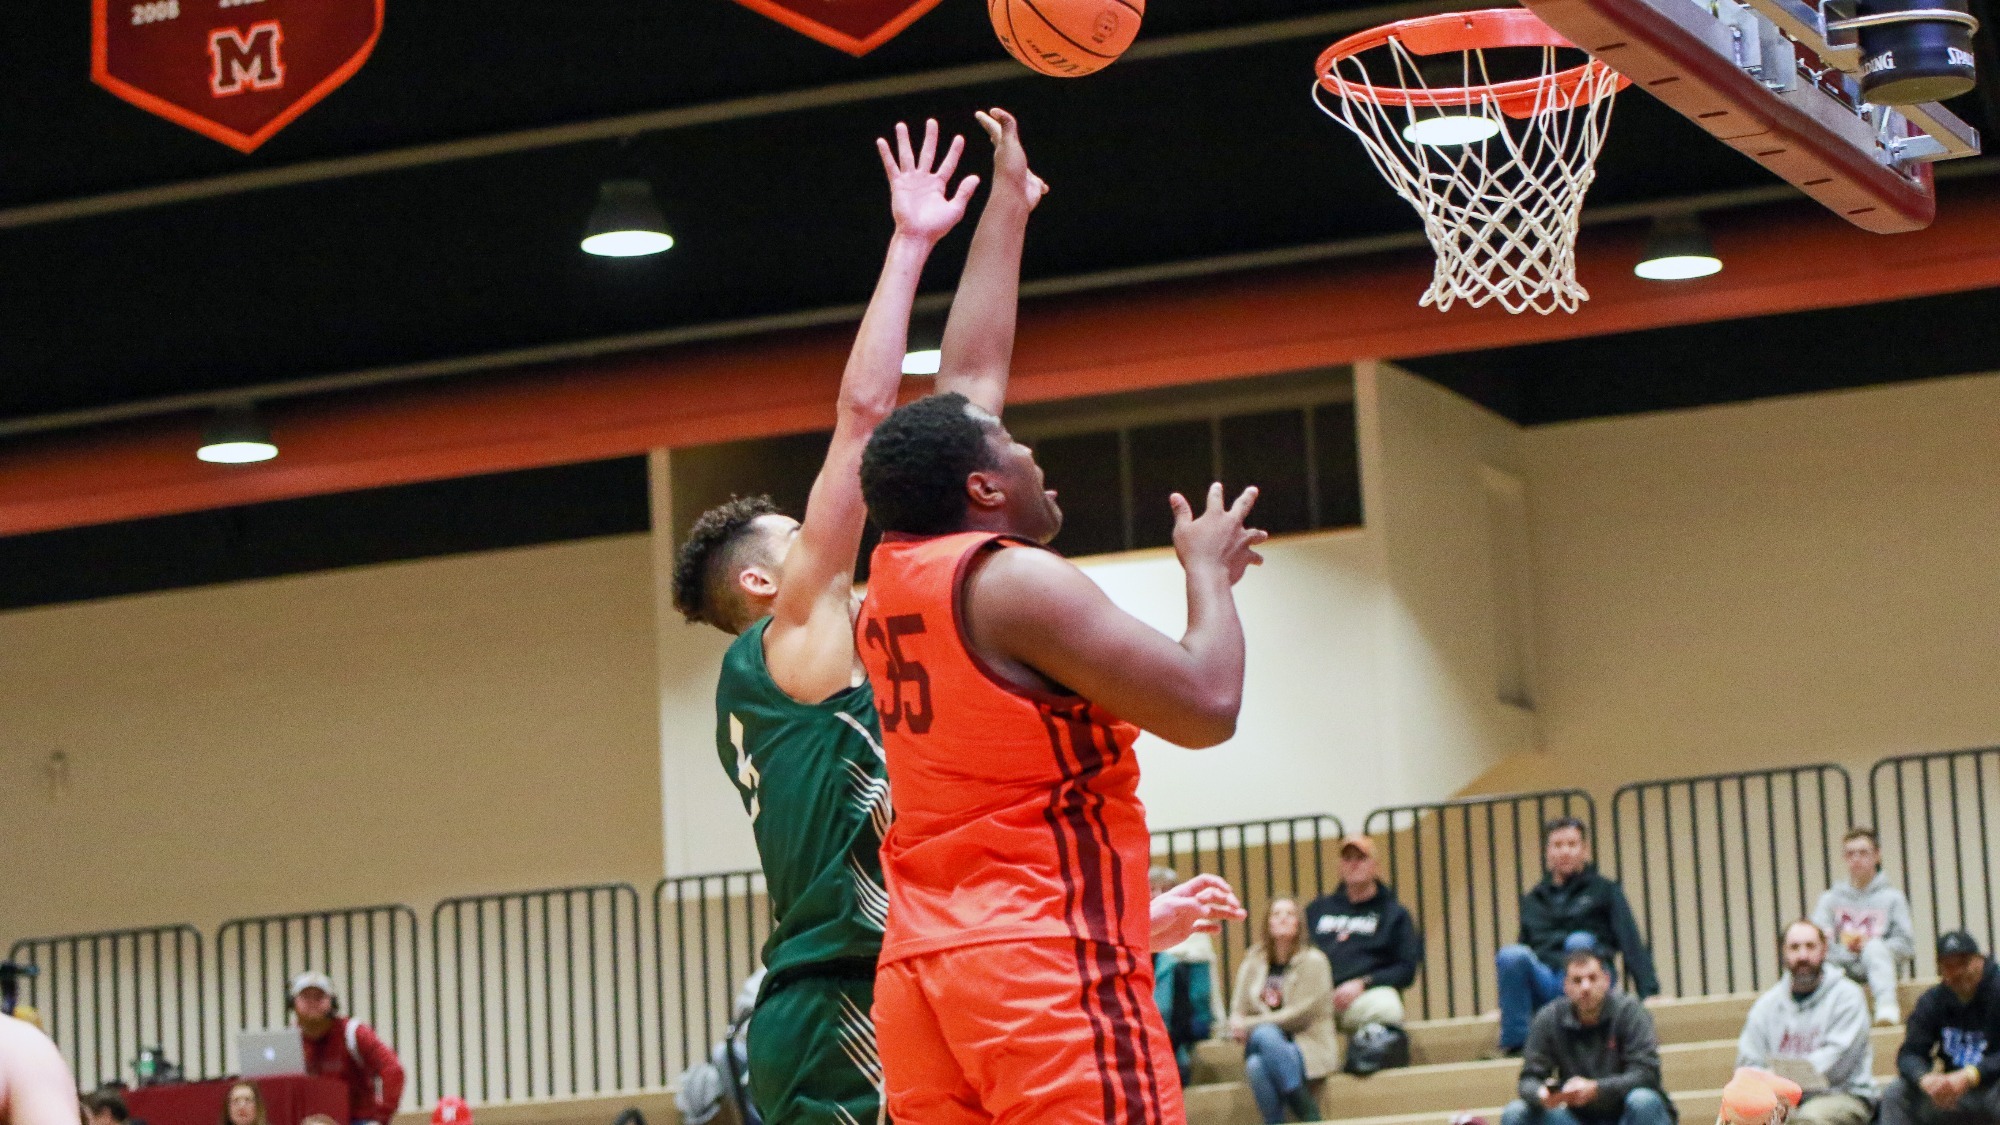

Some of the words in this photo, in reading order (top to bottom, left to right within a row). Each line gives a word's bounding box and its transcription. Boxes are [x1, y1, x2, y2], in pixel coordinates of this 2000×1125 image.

[208, 19, 286, 97] M
[1862, 51, 1896, 73] DING
[865, 613, 934, 734] 35
